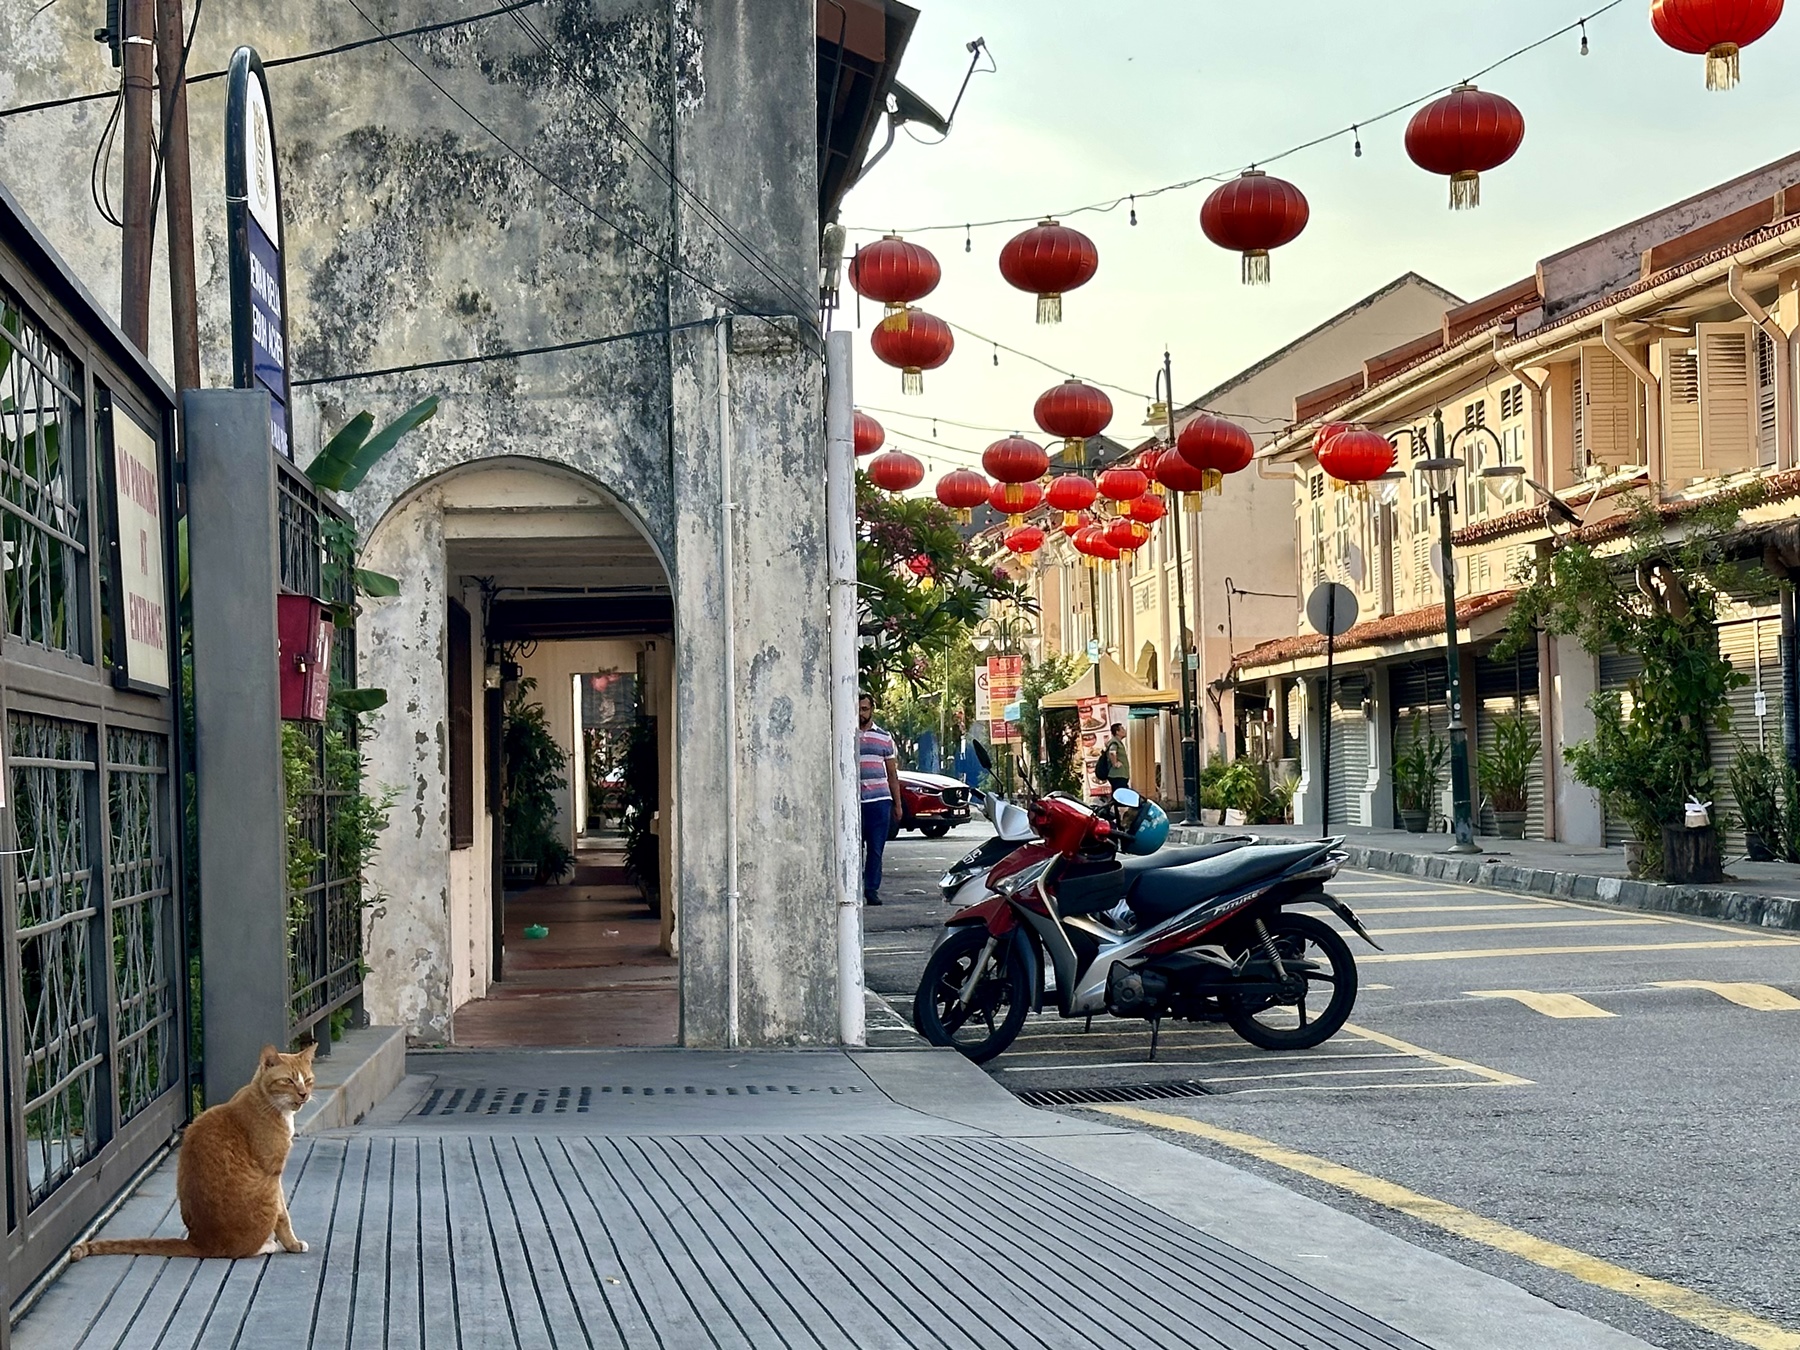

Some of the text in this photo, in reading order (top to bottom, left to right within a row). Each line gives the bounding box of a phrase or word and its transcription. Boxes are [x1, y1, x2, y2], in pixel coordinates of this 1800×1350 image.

[252, 303, 268, 351] EBUH
[117, 444, 130, 498] NO
[128, 591, 163, 651] ENTRANCE
